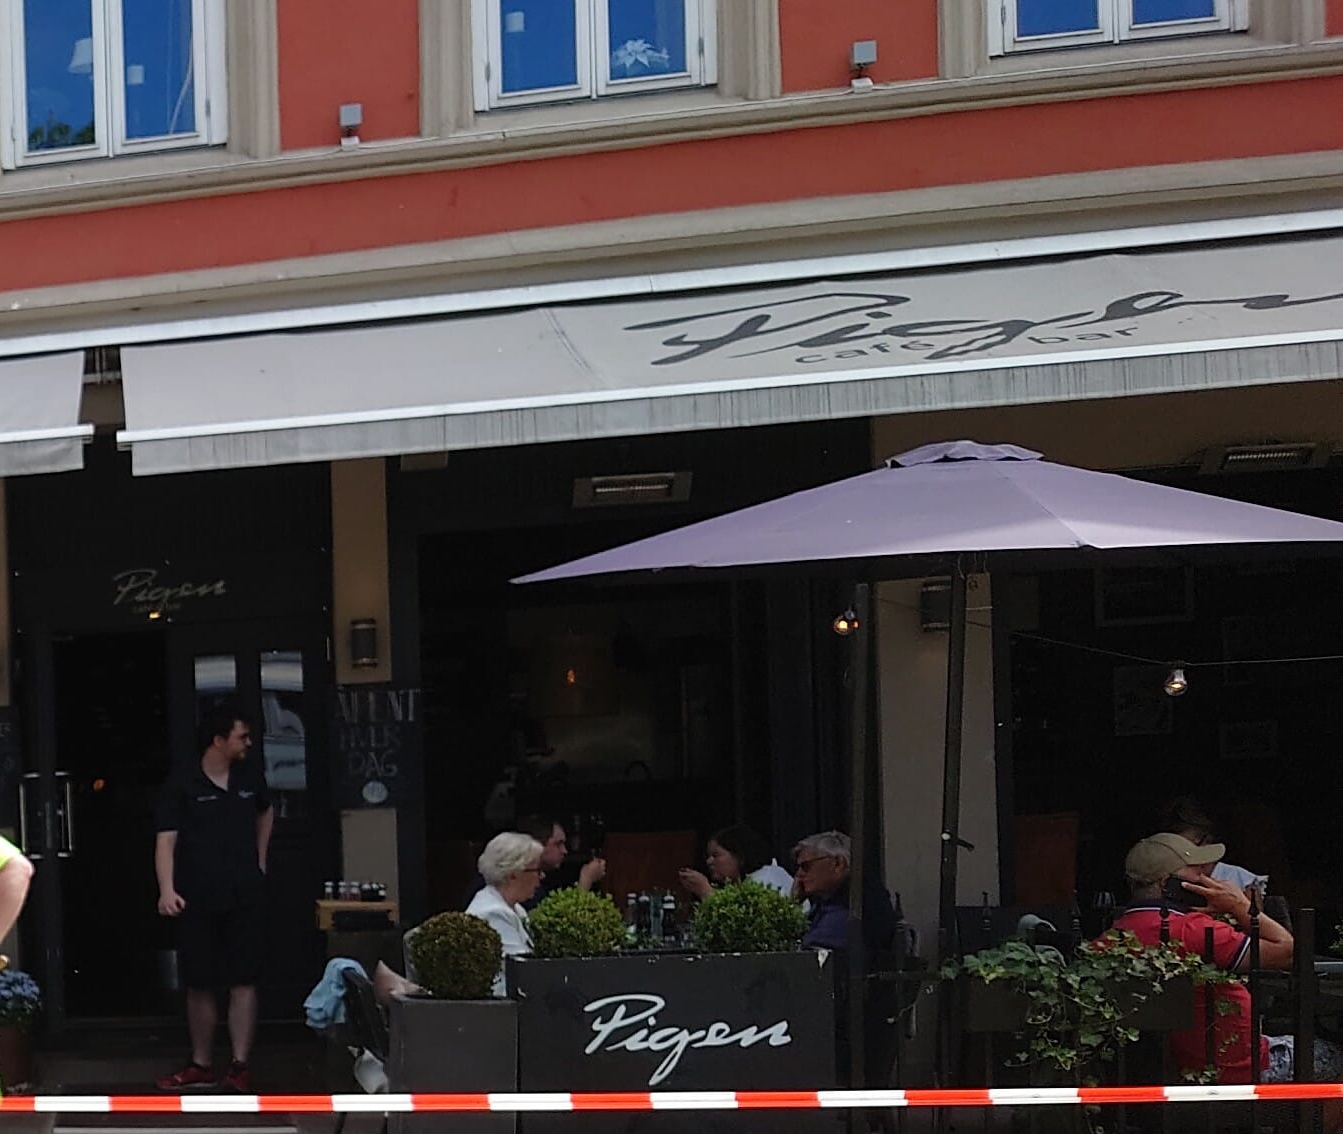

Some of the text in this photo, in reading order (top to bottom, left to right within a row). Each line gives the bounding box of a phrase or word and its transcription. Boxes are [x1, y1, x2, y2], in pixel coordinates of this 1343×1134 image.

[1027, 324, 1139, 345] bar
[113, 568, 227, 612] Pigen
[347, 748, 399, 778] DAG
[583, 994, 792, 1086] Pigen
